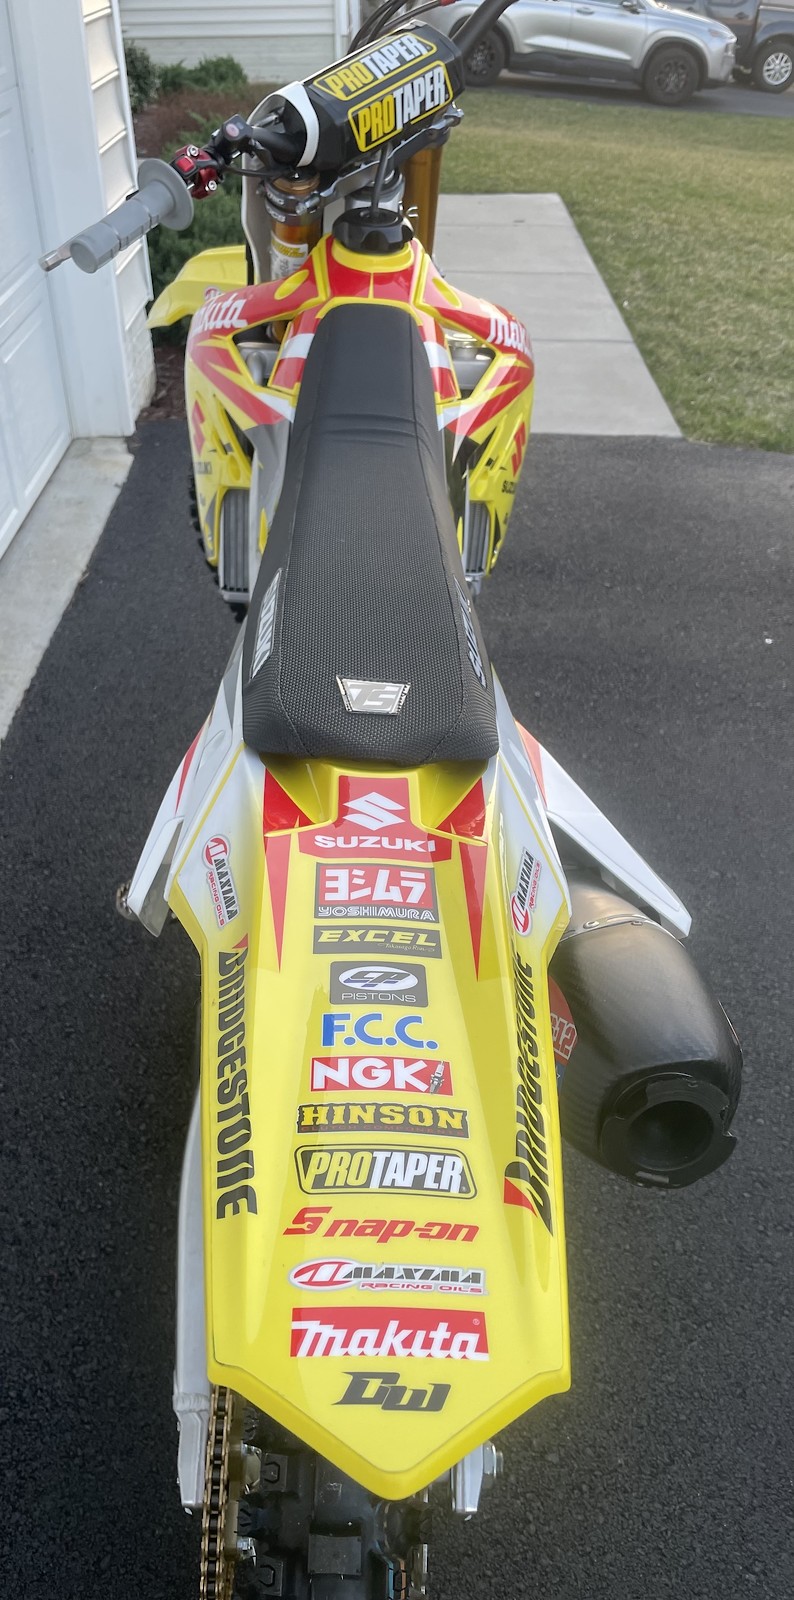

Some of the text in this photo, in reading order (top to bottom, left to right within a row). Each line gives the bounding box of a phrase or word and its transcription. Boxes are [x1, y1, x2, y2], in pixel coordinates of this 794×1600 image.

[325, 33, 429, 99] PROTAPER
[358, 66, 446, 151] PROTAPER
[314, 835, 436, 853] SUZUKI
[213, 858, 239, 920] MAXIMA
[324, 869, 426, 904] ヨシムラ
[517, 850, 534, 911] MAXIMA
[318, 906, 436, 921] YOSHIMURA
[318, 929, 437, 946] EXCEL
[341, 992, 417, 1003] PISTONS
[322, 1012, 439, 1050] F.C.C.
[216, 940, 258, 1220] BRIDGESTONE
[312, 1057, 430, 1093] NGK
[504, 951, 553, 1237] BRIDGESTONE
[300, 1105, 463, 1130] HINSON
[305, 1151, 463, 1194] PROTAPER
[282, 1206, 480, 1244] Snap-on
[342, 1266, 482, 1284] MAXIMA
[361, 1282, 433, 1290] RACING
